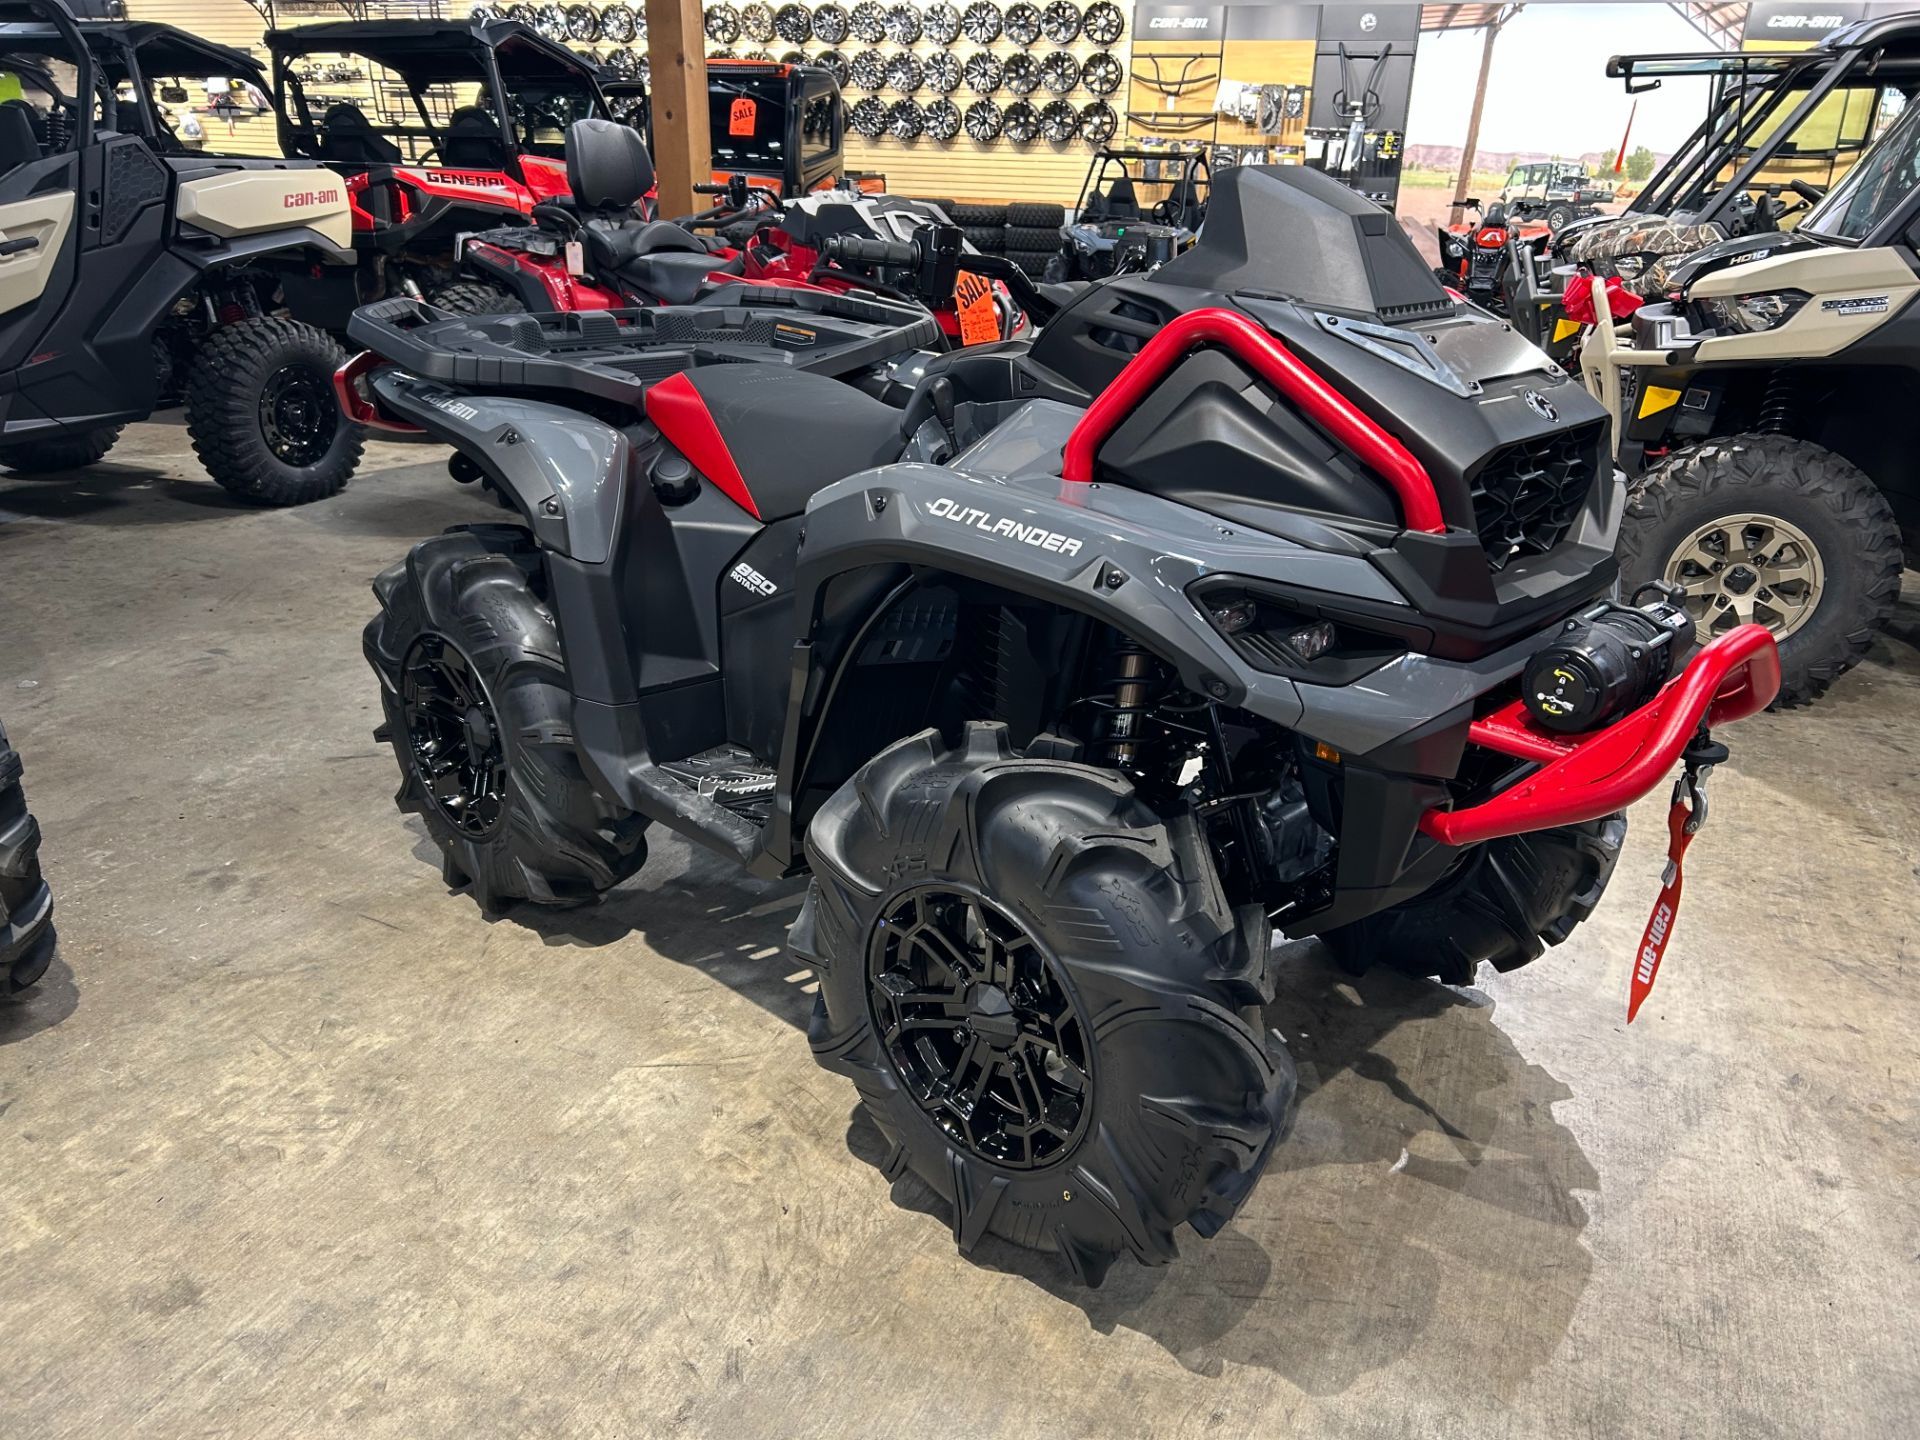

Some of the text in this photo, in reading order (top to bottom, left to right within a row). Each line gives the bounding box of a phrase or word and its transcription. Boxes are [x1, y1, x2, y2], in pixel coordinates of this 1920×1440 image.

[1148, 17, 1208, 28] can-am
[1767, 15, 1843, 28] can-am
[733, 106, 753, 121] SALE
[284, 189, 338, 208] can-am
[1729, 249, 1770, 265] HD10
[957, 274, 988, 310] SALE
[925, 497, 1084, 557] OUTLANDER
[730, 570, 757, 593] ROTAX
[734, 562, 778, 595] 850
[1637, 902, 1671, 984] can-am
